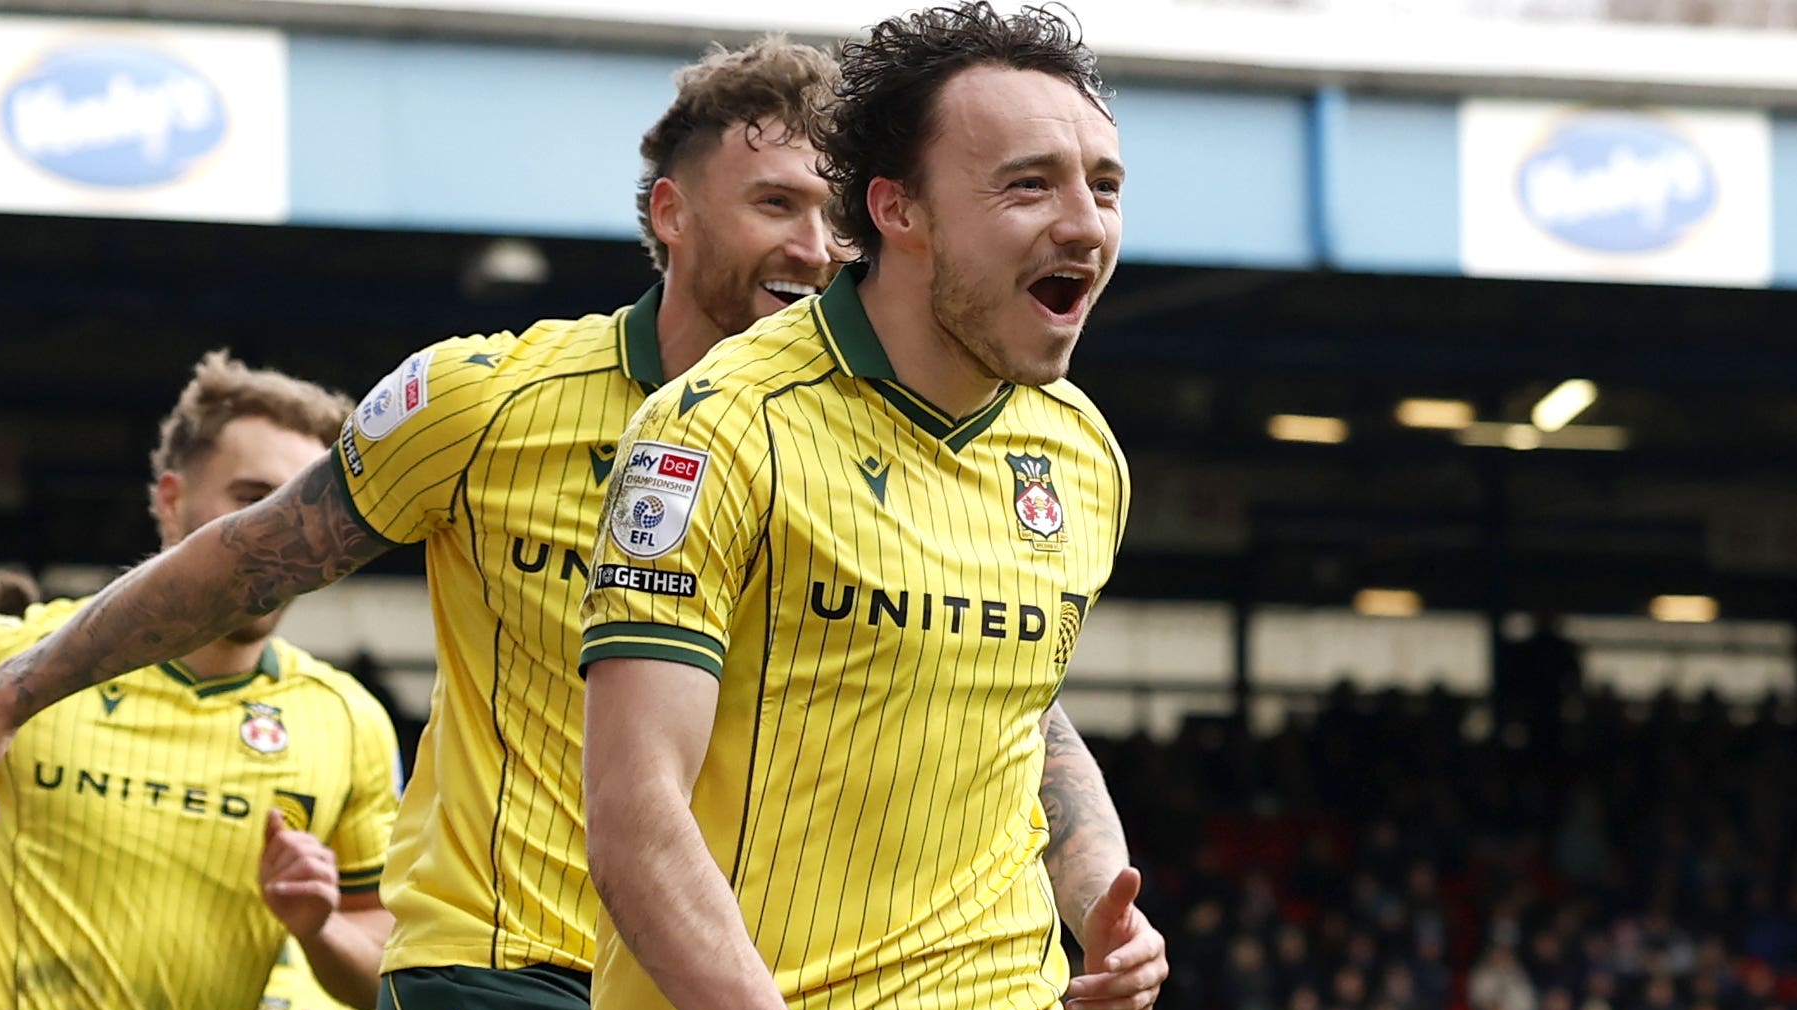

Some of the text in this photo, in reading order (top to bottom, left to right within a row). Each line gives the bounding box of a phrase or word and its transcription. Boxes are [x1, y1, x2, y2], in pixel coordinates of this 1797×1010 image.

[631, 452, 695, 476] sky bet
[625, 474, 692, 493] CHAMPIONSHIP
[630, 530, 655, 547] EFL
[811, 581, 1046, 641] UNITED
[34, 761, 251, 819] UNITED
